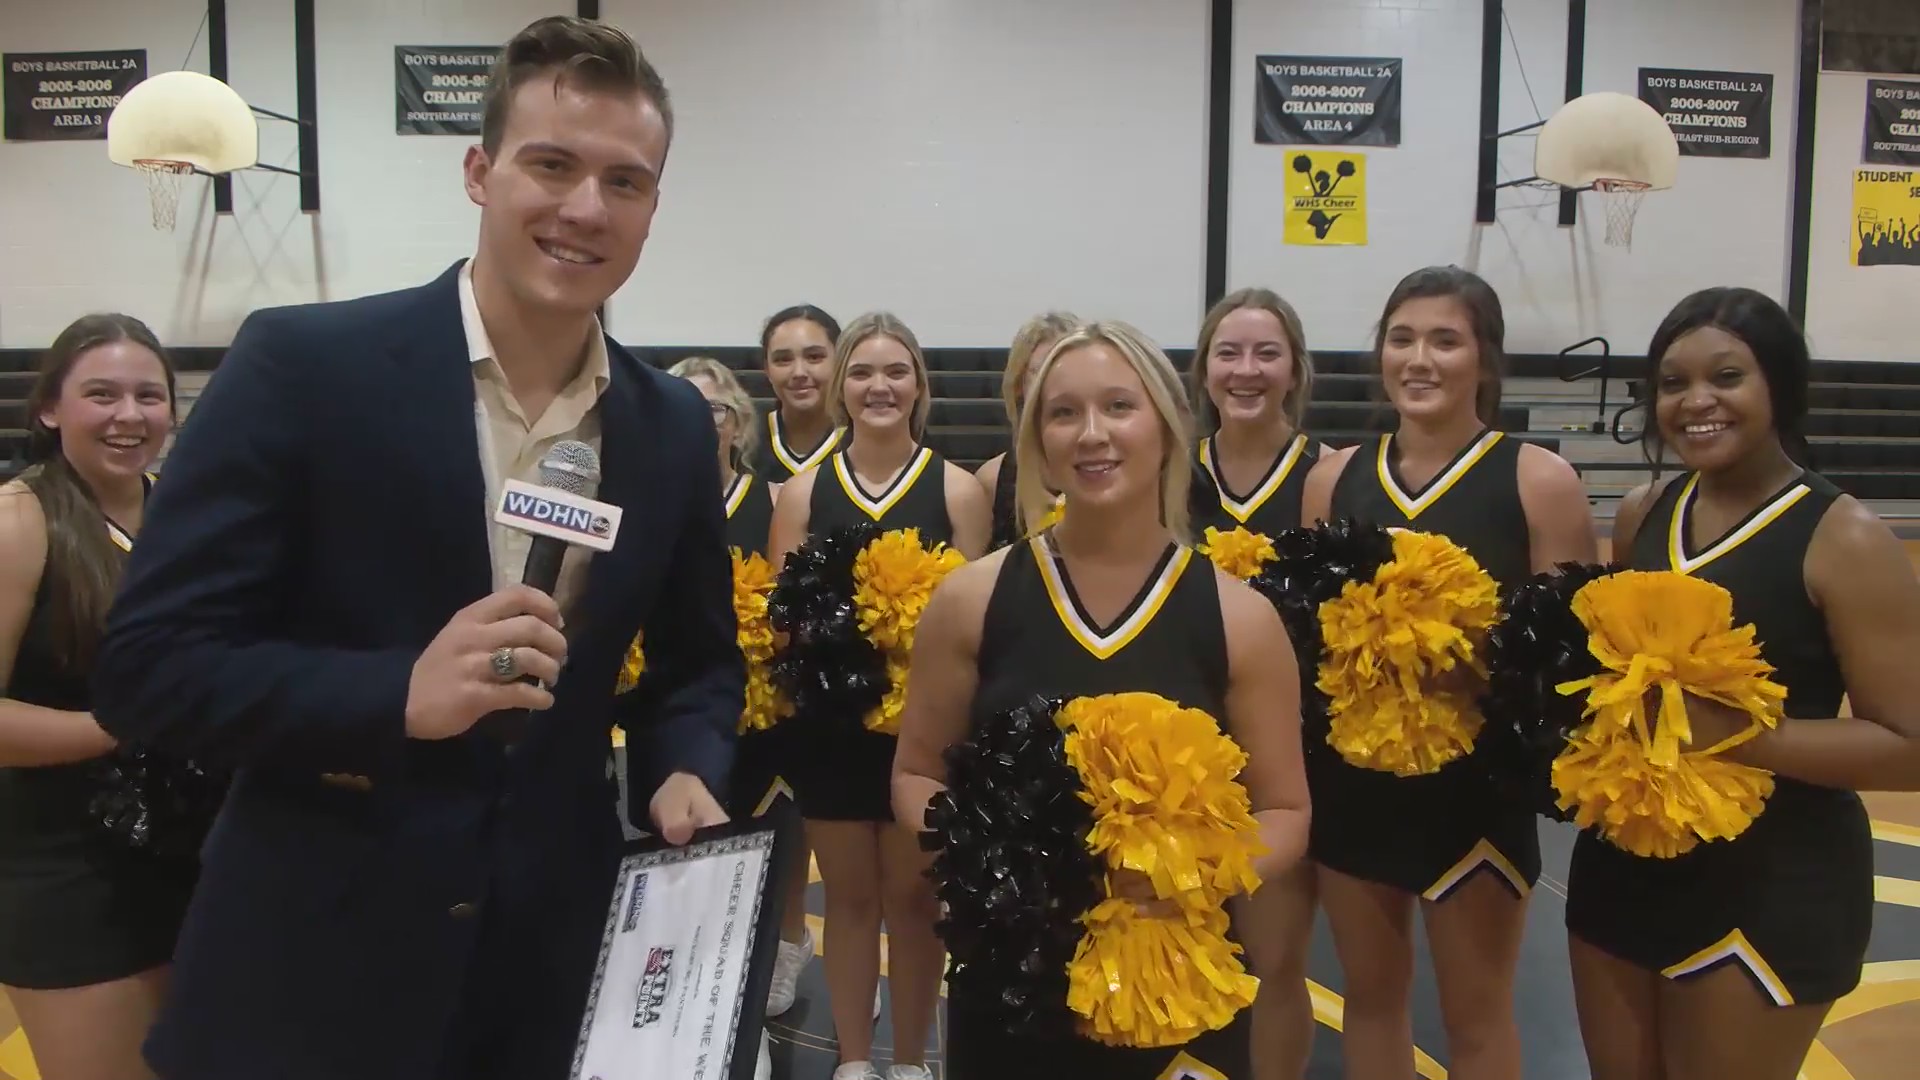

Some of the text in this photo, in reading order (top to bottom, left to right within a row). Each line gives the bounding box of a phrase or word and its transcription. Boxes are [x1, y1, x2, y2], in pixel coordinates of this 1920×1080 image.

[12, 59, 137, 72] BOYS BASKETBALL 2A
[405, 54, 437, 65] BOYS
[1266, 65, 1392, 78] BOYS BASKETBALL 2A
[39, 79, 112, 93] 2005-2006
[1291, 85, 1366, 98] 2006-2007
[1647, 77, 1763, 93] BOYS BASKETBALL 2A
[1875, 88, 1920, 100] BOYS BA
[31, 95, 121, 110] CHAMPIONS
[1282, 101, 1374, 115] CHAMPIONS
[1670, 97, 1740, 112] 2006-2007
[53, 115, 102, 127] AREA 3
[407, 111, 471, 121] SOUTHEAST
[1663, 112, 1747, 128] CHAMPIONS
[1303, 119, 1353, 131] AREA 4
[1703, 134, 1760, 145] SUB-REGION
[1857, 170, 1912, 183] STUDENT
[1909, 186, 1920, 198] SE
[1295, 199, 1355, 208] WHS Cheer
[508, 493, 590, 530] WDHN
[646, 948, 674, 1024] EXTRA
[700, 1011, 715, 1048] THE
